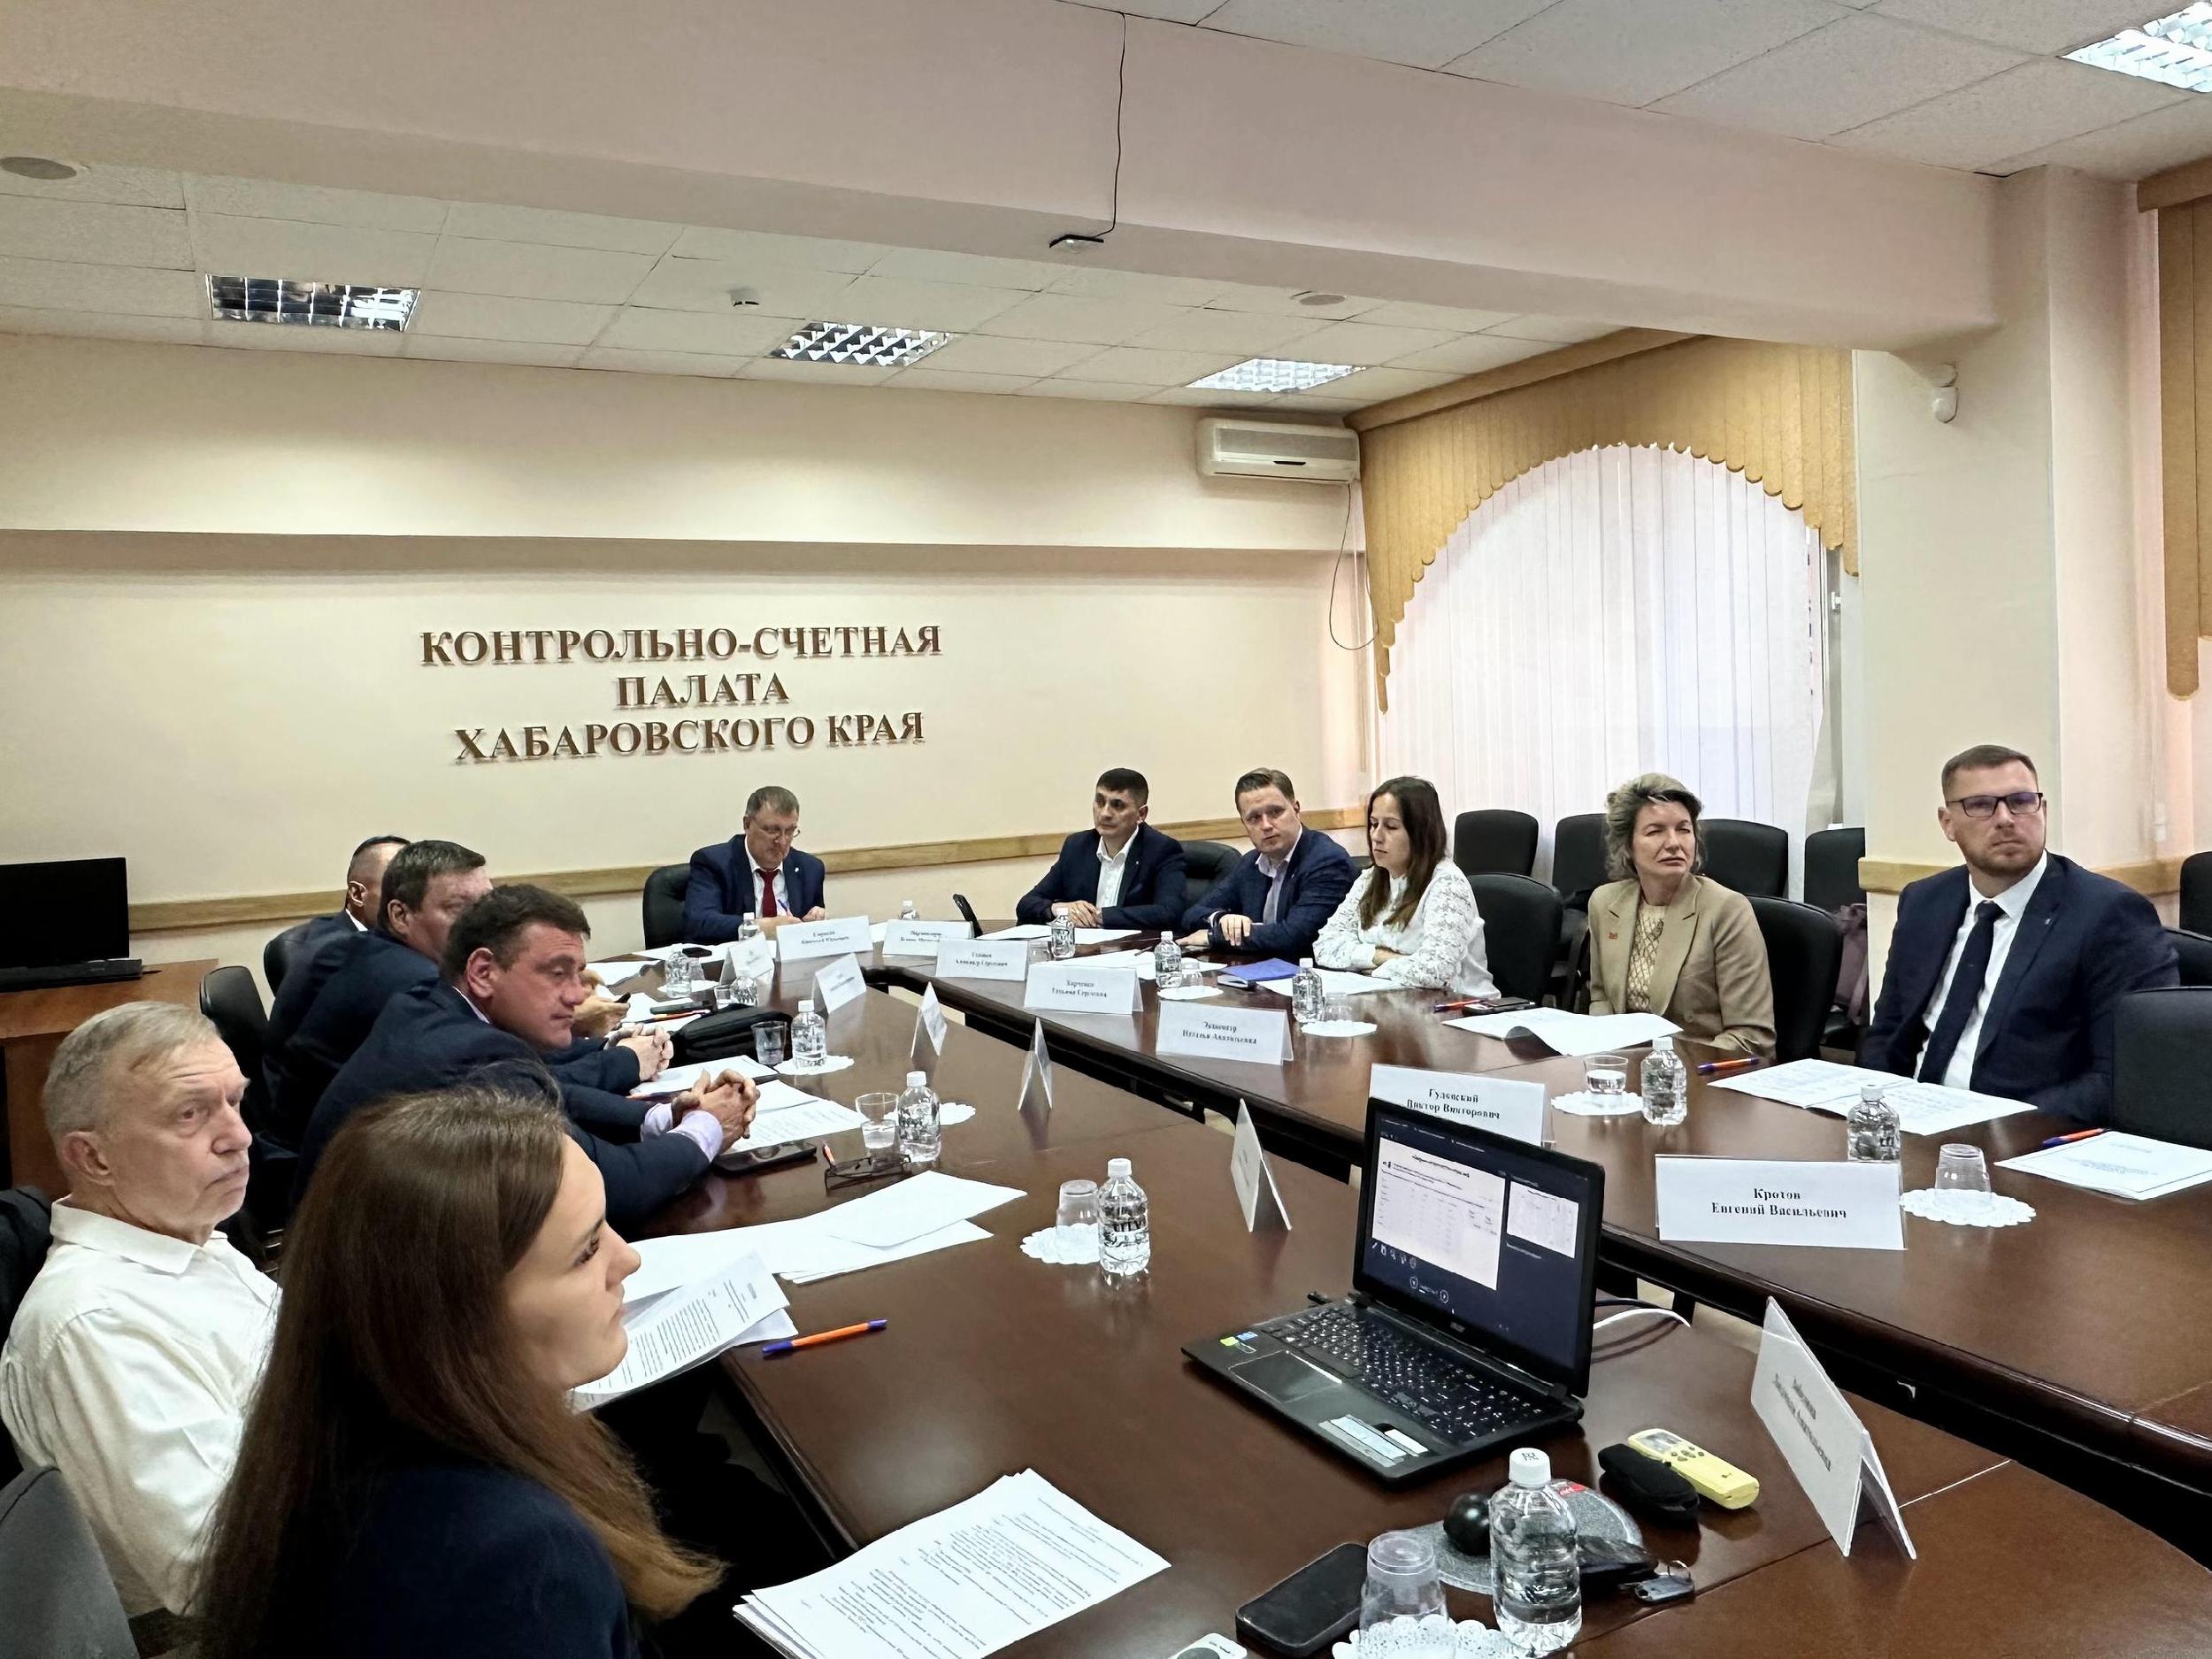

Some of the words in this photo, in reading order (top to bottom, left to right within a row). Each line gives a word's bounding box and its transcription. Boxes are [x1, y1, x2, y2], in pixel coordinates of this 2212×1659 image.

[420, 625, 941, 664] КОНТРОЛЬНО-СЧЕТНАЯ
[616, 672, 789, 706] ПАЛАТА
[455, 716, 814, 759] ХАБАРОВСКОГО
[828, 711, 923, 742] КРАЯ
[1407, 1099, 1440, 1114] Виктор
[1442, 1103, 1501, 1119] Викторович
[1753, 1187, 1801, 1202] Кротов
[1711, 1202, 1765, 1215] Евгений
[1770, 1204, 1847, 1218] Васильевич
